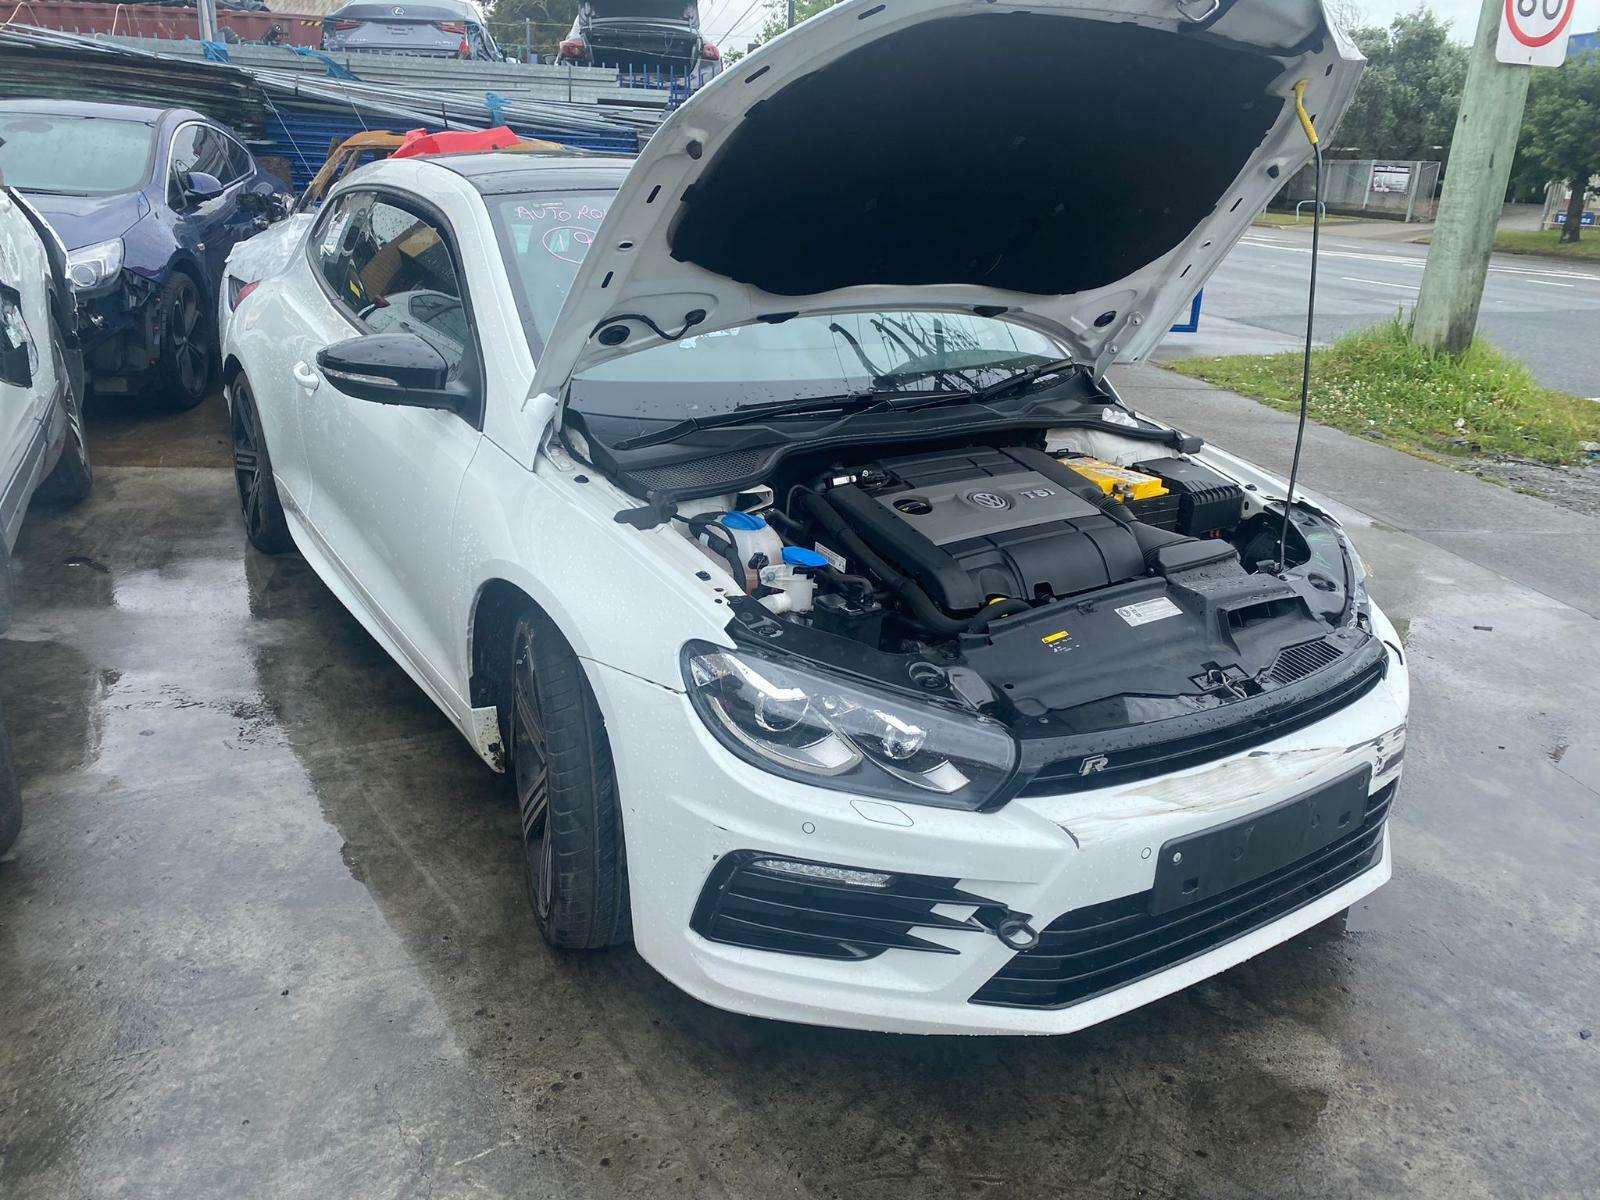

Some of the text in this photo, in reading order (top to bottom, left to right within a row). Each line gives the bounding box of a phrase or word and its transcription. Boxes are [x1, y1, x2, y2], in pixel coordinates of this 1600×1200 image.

[515, 205, 572, 221] AUTO
[1018, 488, 1056, 500] TSI
[1079, 753, 1109, 777] R
